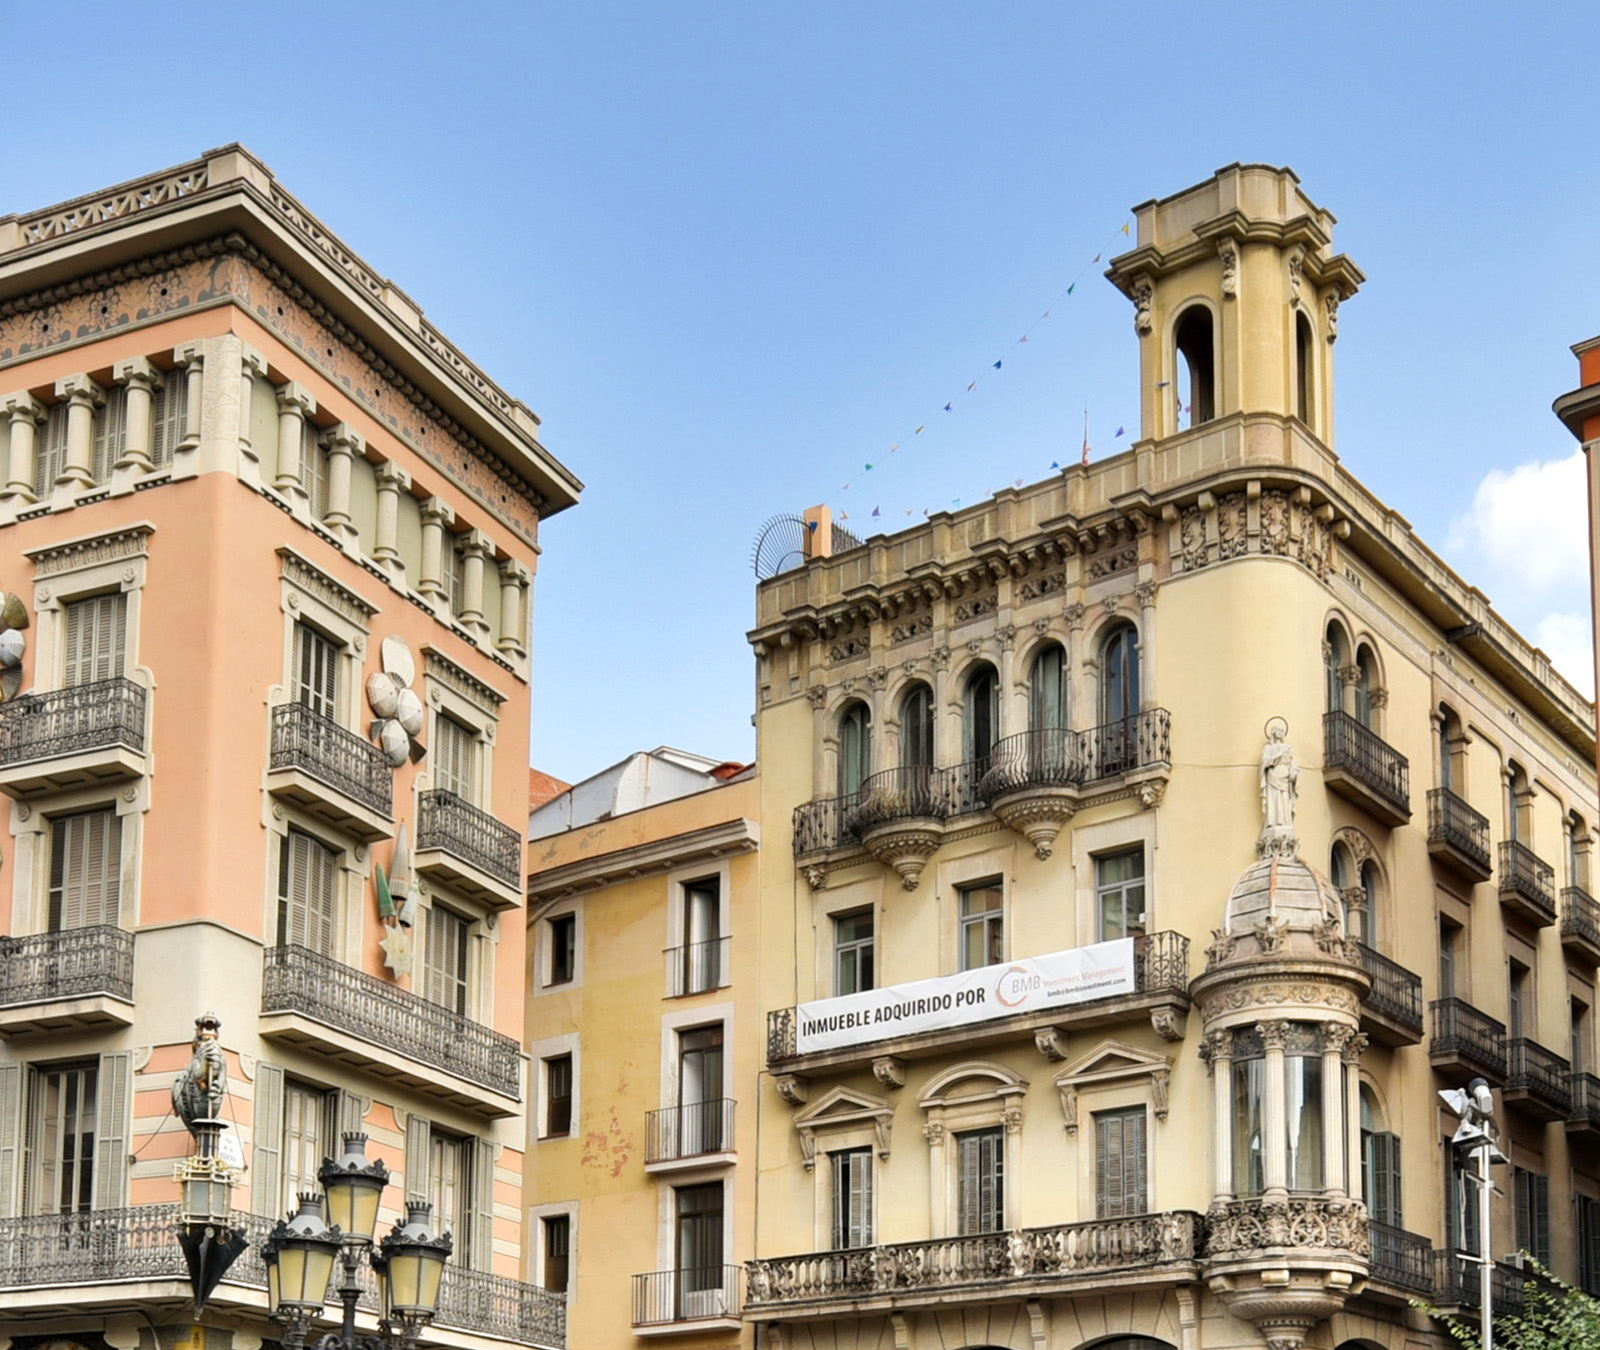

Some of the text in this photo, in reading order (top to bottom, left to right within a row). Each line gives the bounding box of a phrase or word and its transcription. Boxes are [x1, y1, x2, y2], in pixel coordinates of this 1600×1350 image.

[1080, 966, 1125, 982] Management
[1011, 975, 1041, 994] BMB
[802, 987, 986, 1037] INMUEBLE ADQUIRIDO POR
